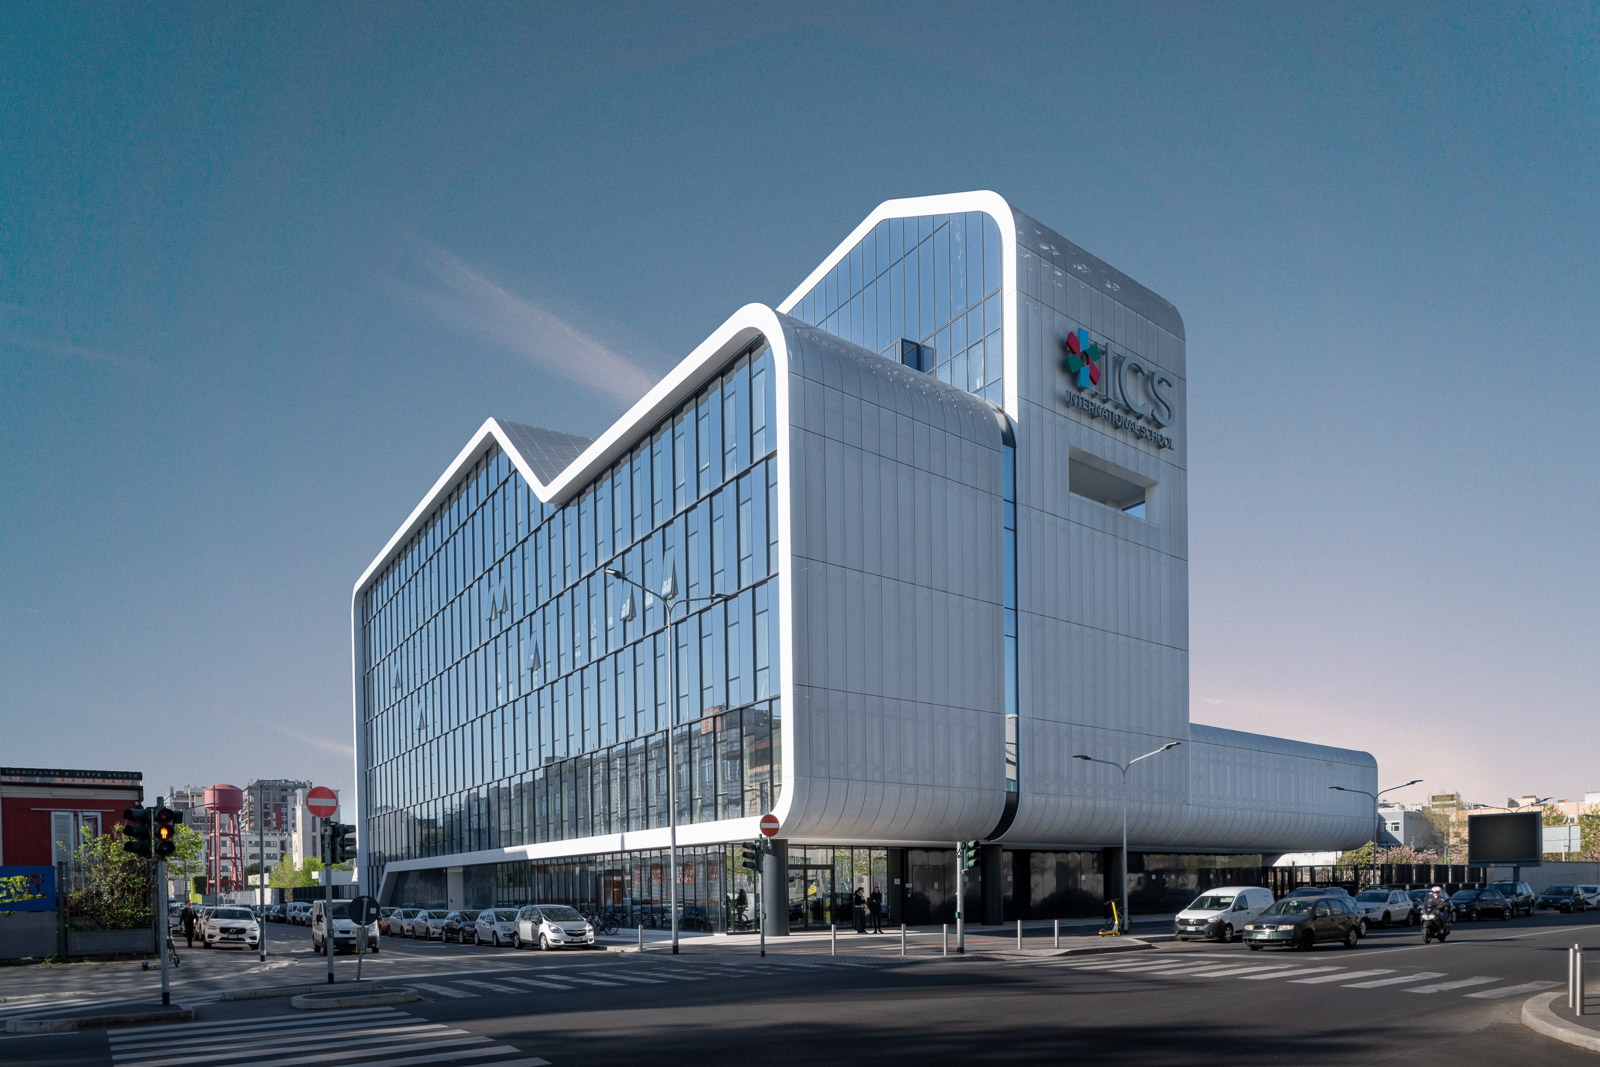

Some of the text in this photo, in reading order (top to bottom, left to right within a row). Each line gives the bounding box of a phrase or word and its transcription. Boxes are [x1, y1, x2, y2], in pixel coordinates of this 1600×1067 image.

[1065, 389, 1175, 451] INTERNATIONAL SCHOOL
[1105, 342, 1177, 428] ICS
